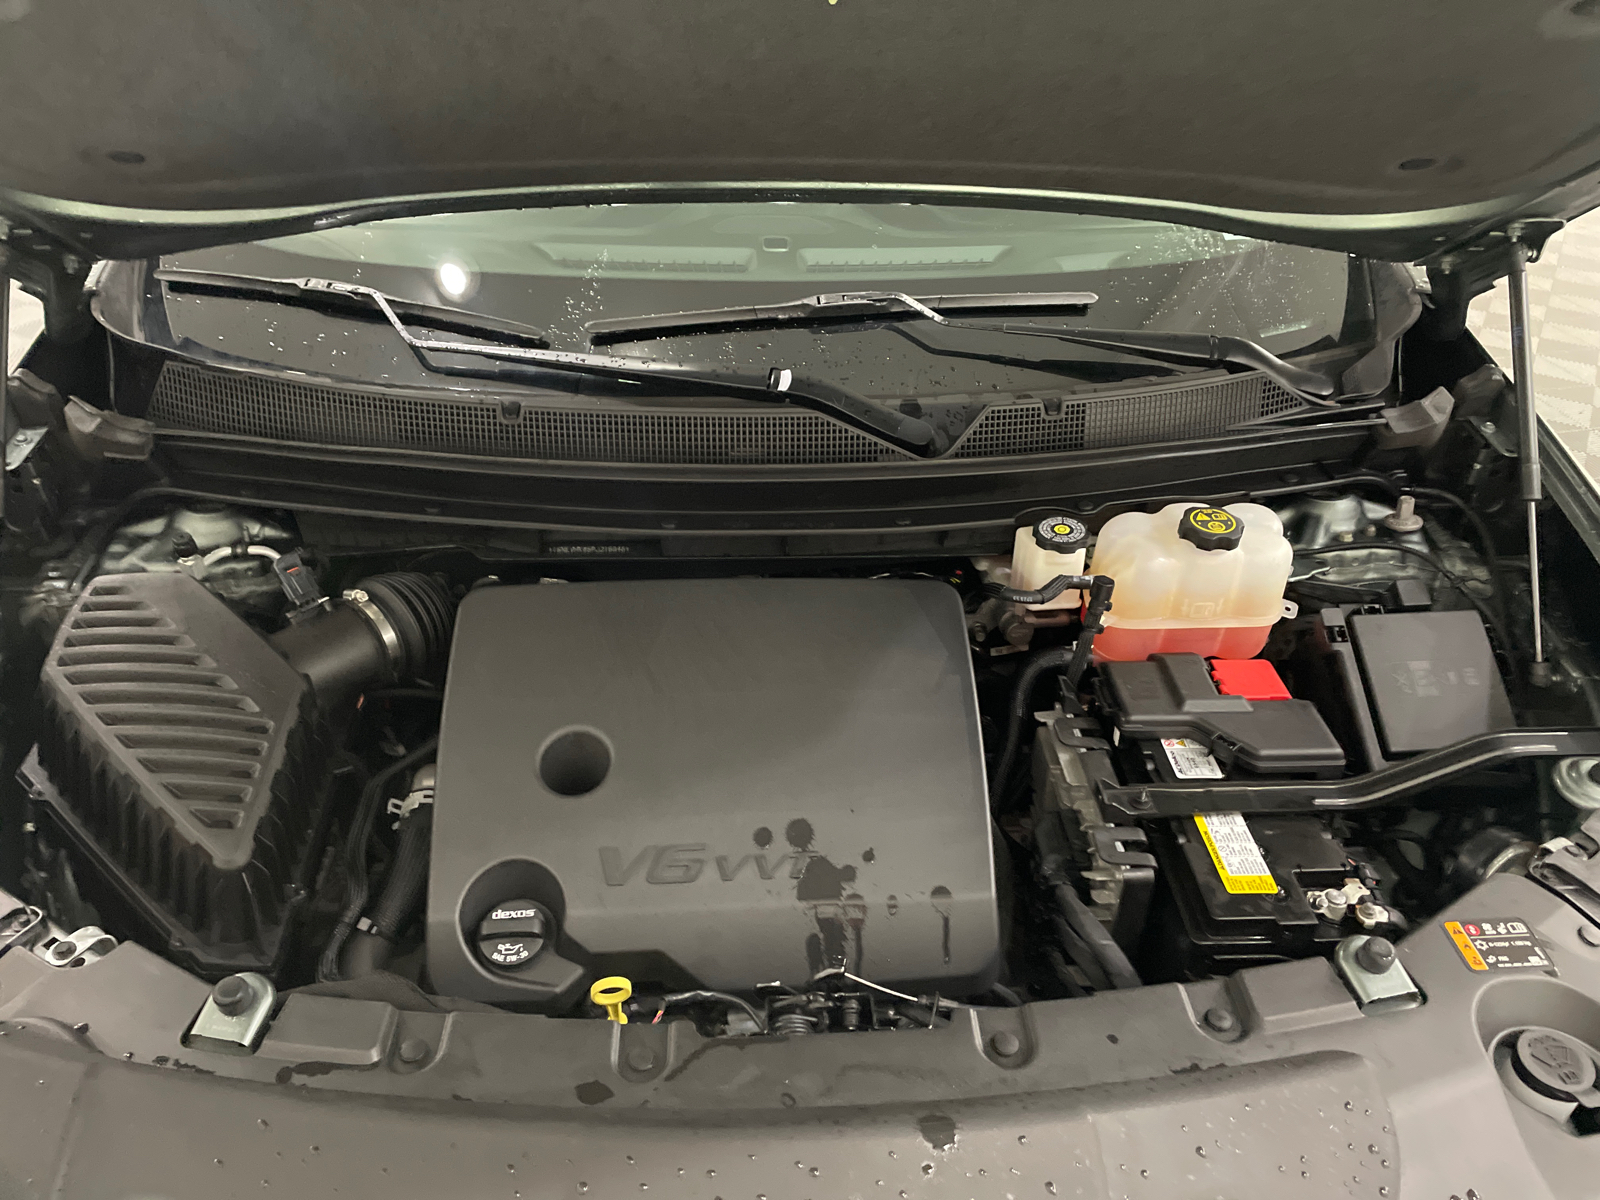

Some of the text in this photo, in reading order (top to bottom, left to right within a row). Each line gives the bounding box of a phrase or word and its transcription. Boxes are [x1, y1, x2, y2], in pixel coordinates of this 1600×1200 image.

[598, 842, 707, 887] V6
[491, 908, 537, 920] dexos
[491, 950, 529, 962] SAE 5W-30
